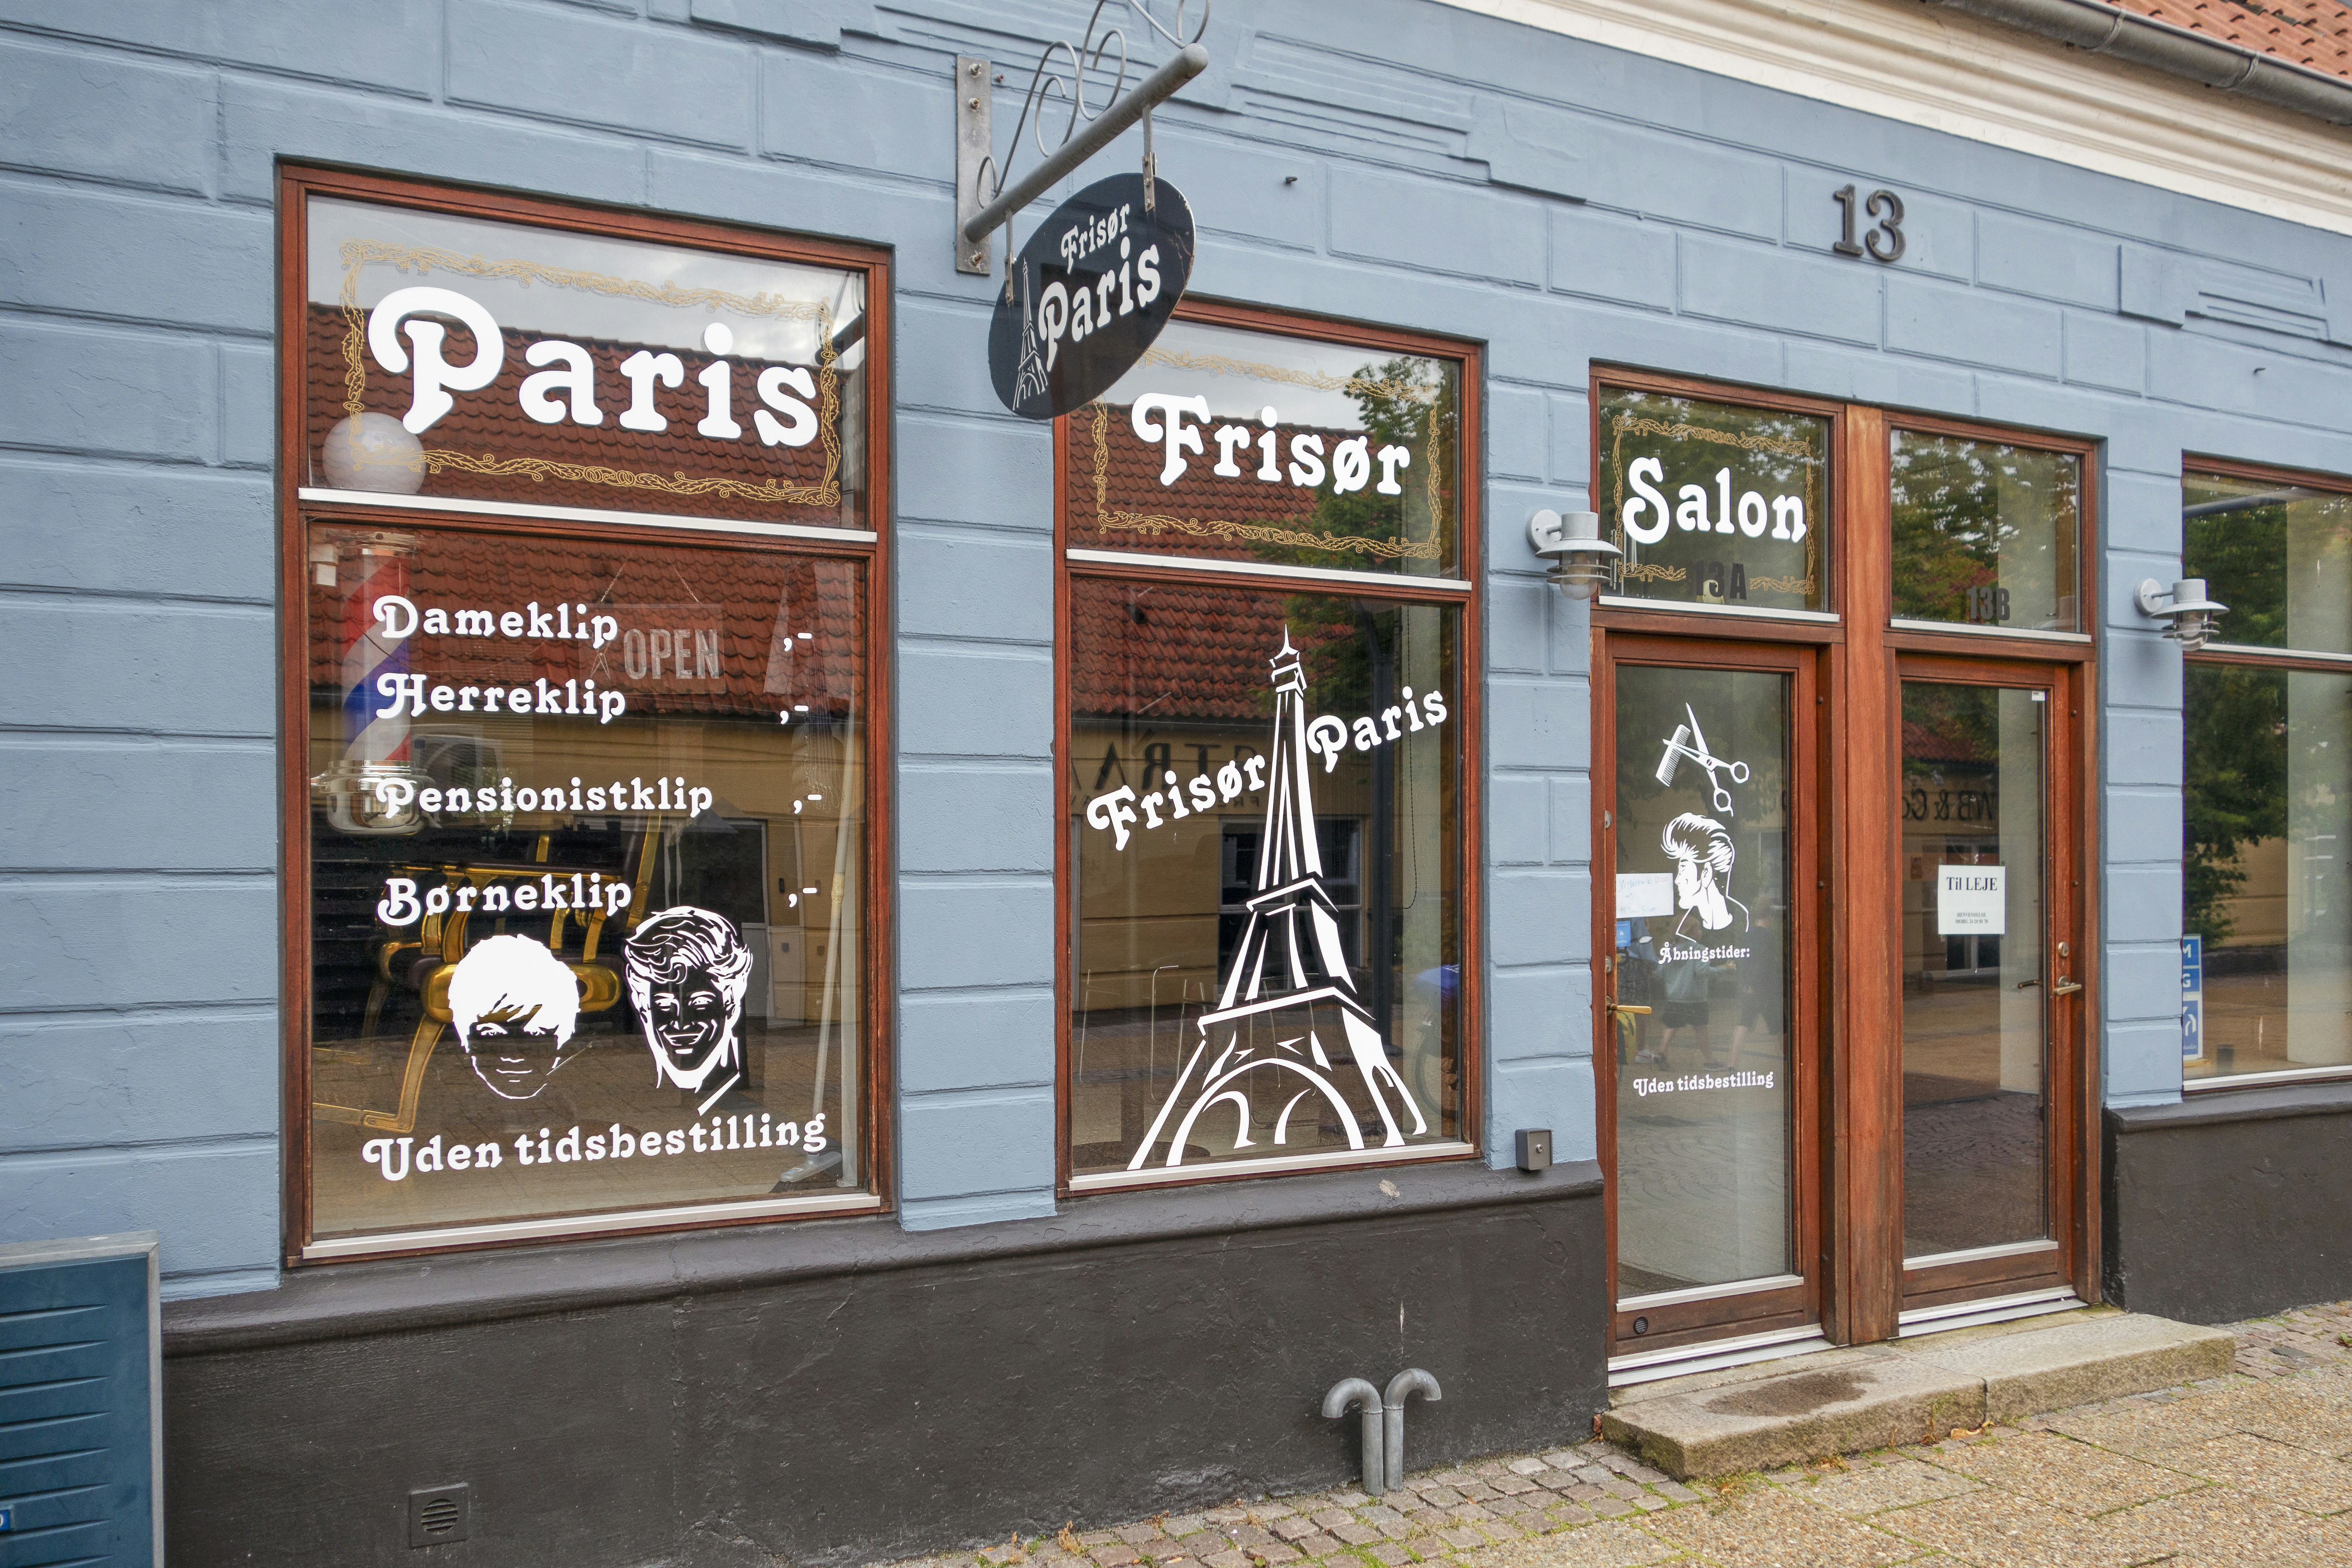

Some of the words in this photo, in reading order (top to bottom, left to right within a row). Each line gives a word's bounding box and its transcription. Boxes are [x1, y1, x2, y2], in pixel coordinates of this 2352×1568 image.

[1061, 203, 1130, 275] Frisør
[1833, 183, 1907, 262] 13
[1038, 236, 1161, 372] Paris
[368, 286, 818, 447] Paris
[1131, 392, 1410, 495] Frisør
[1622, 457, 1807, 544] Salon
[1693, 560, 1747, 600] 13A
[1966, 586, 2010, 620] 13B
[373, 595, 618, 649] Dameklip
[624, 629, 720, 680] OPEN
[376, 672, 625, 724] Herreklip
[1086, 754, 1265, 851] Frisør
[1306, 686, 1448, 773] Paris
[375, 777, 713, 819] Pensionistklip
[377, 872, 631, 926] Børneklip
[1946, 876, 1962, 891] Til
[1966, 877, 1998, 891] LEJE
[1658, 941, 1750, 965] Åbningstider:
[1633, 1077, 1675, 1096] Uden
[1677, 1070, 1774, 1091] tidsbestilling
[362, 1134, 503, 1181] Uden
[514, 1112, 827, 1165] tidsbestilling
